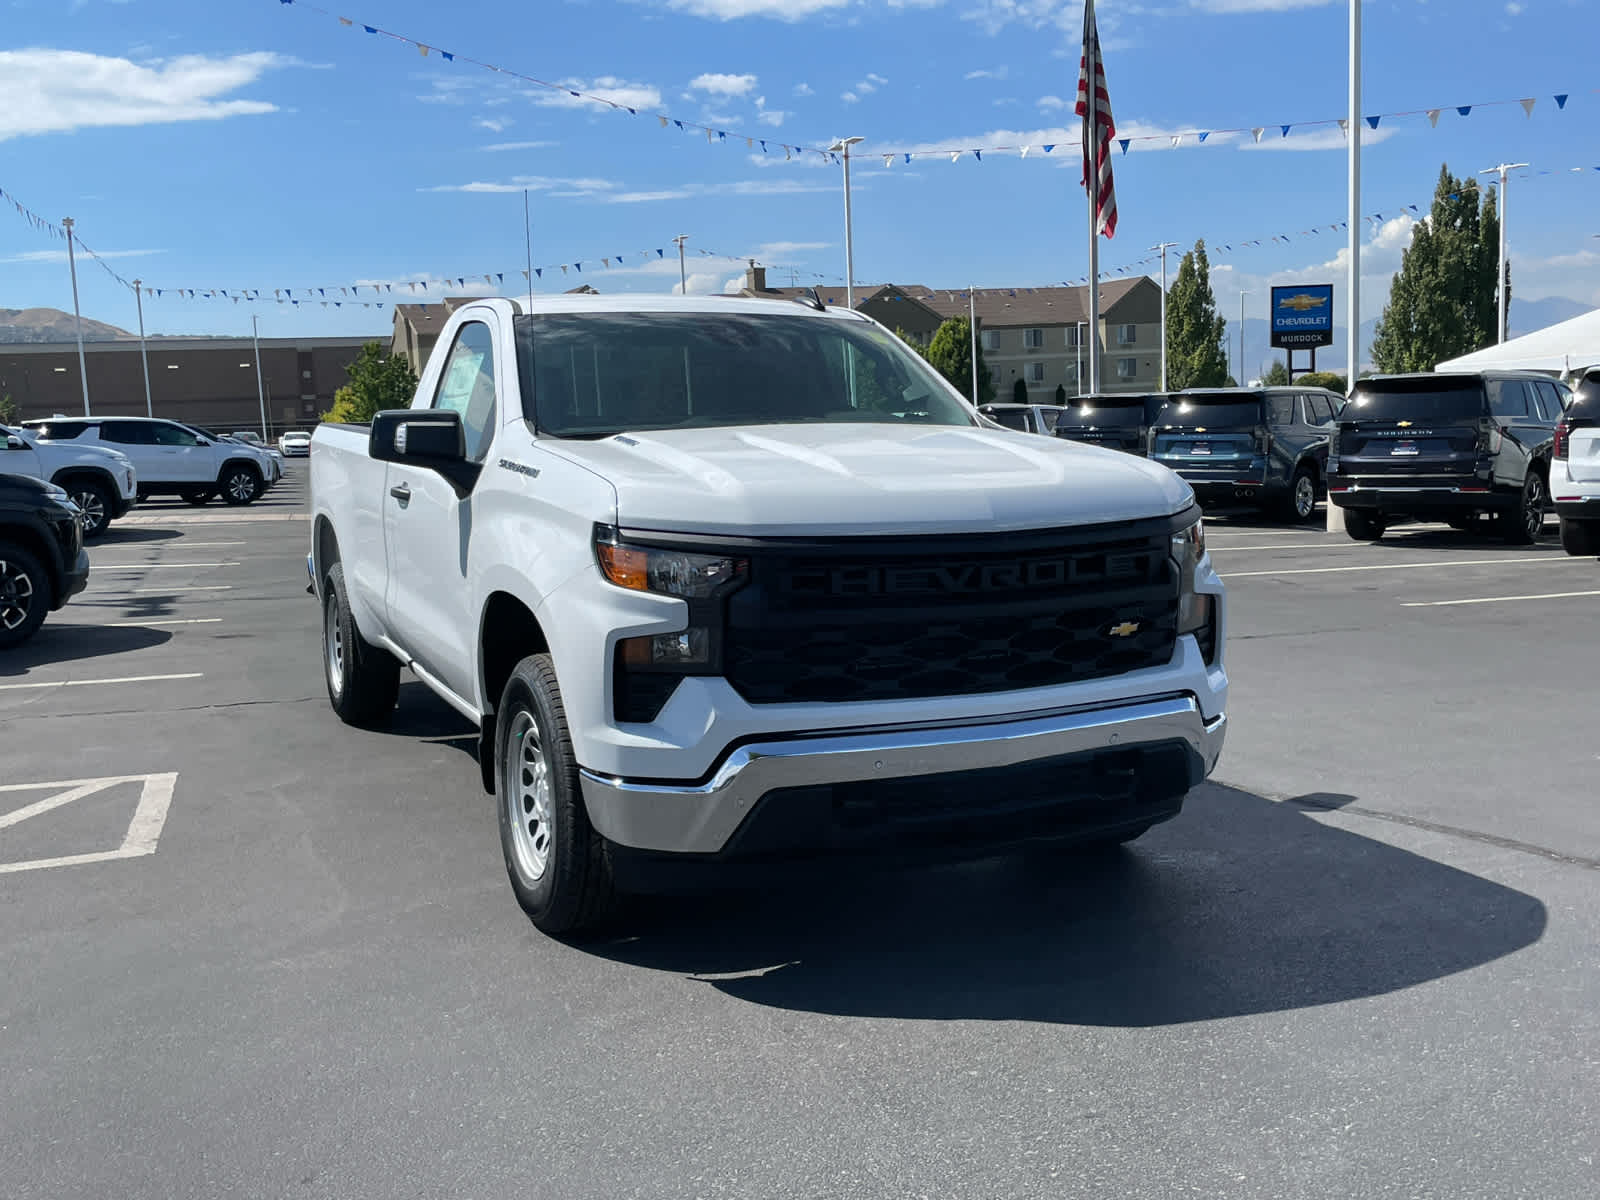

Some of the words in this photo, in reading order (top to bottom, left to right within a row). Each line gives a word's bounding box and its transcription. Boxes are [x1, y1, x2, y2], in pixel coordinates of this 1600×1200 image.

[1276, 316, 1328, 326] CHEVROLET
[1280, 334, 1323, 342] MURDOCK
[778, 551, 1166, 595] CHEVROLET
